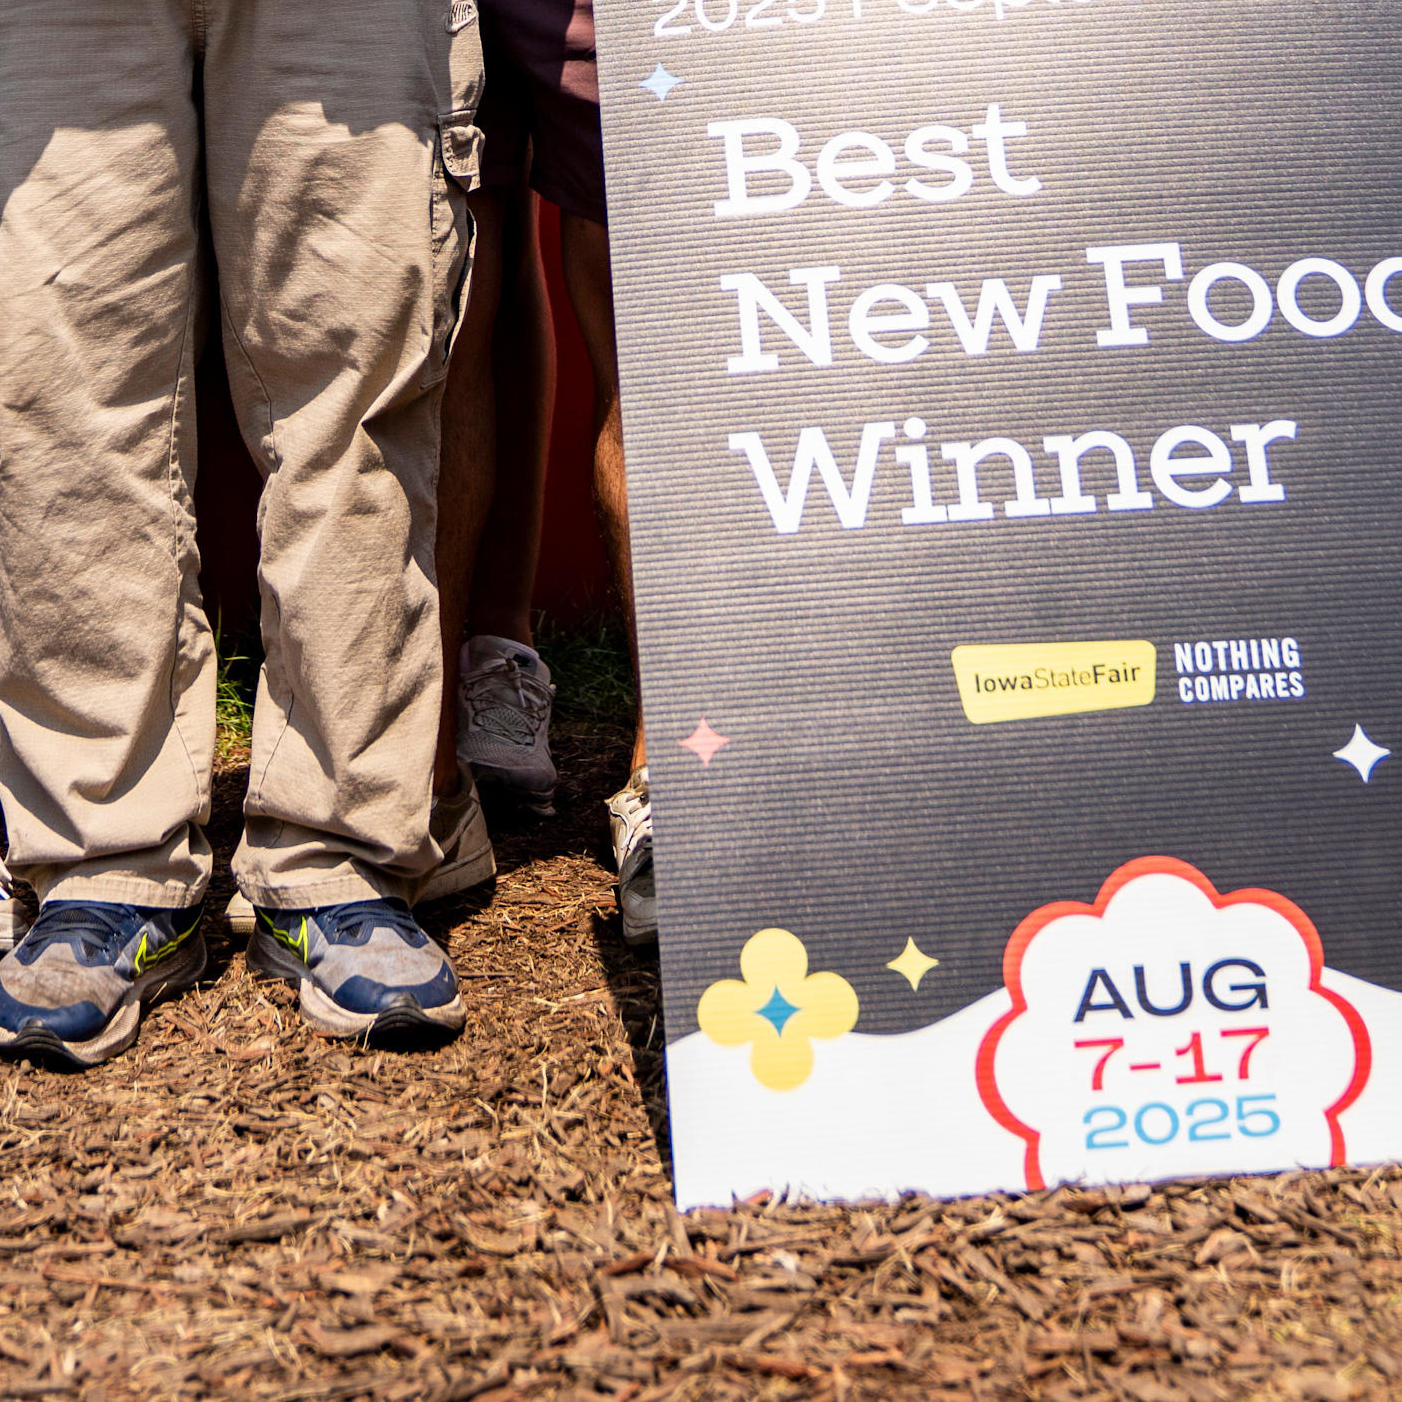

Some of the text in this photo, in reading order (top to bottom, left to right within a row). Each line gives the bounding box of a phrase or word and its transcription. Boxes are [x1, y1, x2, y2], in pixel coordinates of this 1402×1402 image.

[707, 103, 1043, 216] Best
[719, 265, 1061, 373] New
[728, 417, 1297, 534] Winner
[1174, 637, 1301, 674] NOTHING
[1178, 672, 1305, 703] COMPARES
[1073, 958, 1270, 1023] AUG
[1082, 1093, 1281, 1149] 2025
